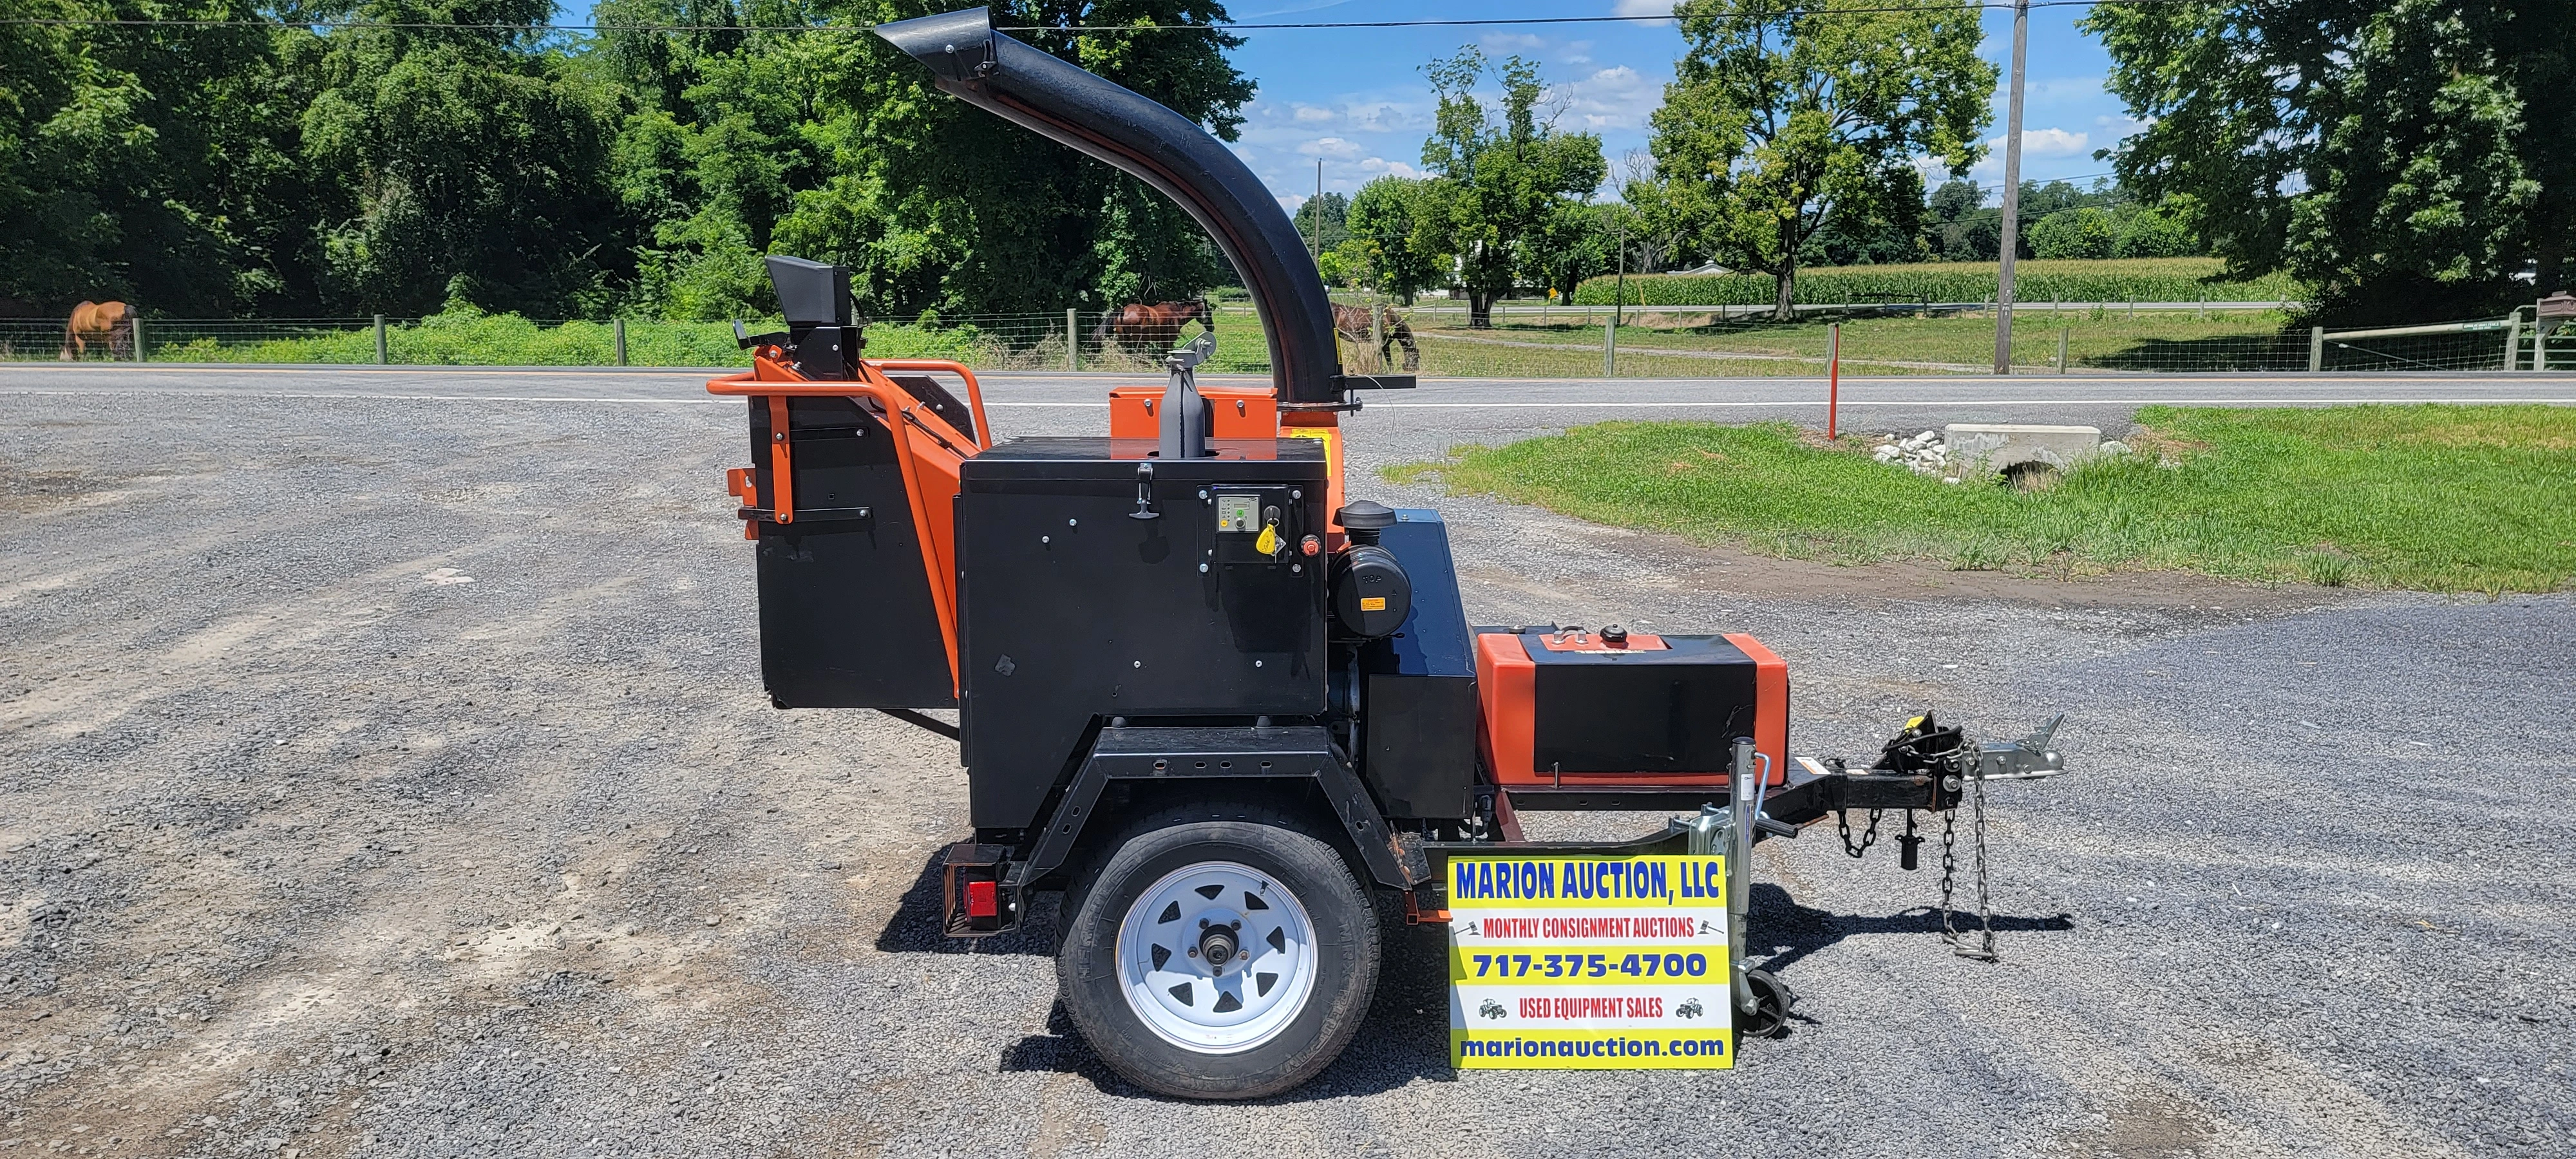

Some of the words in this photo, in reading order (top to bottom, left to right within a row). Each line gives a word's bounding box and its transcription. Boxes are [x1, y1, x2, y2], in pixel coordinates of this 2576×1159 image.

[1362, 574, 1382, 584] TOP
[1456, 862, 1554, 899] MARION
[1561, 862, 1674, 905] AUCTION,
[1680, 861, 1719, 898] LLC
[1484, 918, 1539, 938] MONTHLY
[1543, 918, 1631, 938] CONSIGNMENT
[1633, 917, 1694, 938] AUCTIONS
[1472, 953, 1707, 977] 717-375-4700
[1519, 997, 1551, 1018] USED
[1555, 997, 1624, 1019] EQUIPMENT
[1626, 997, 1663, 1017] SALES
[1461, 1037, 1724, 1057] marionauction.com
